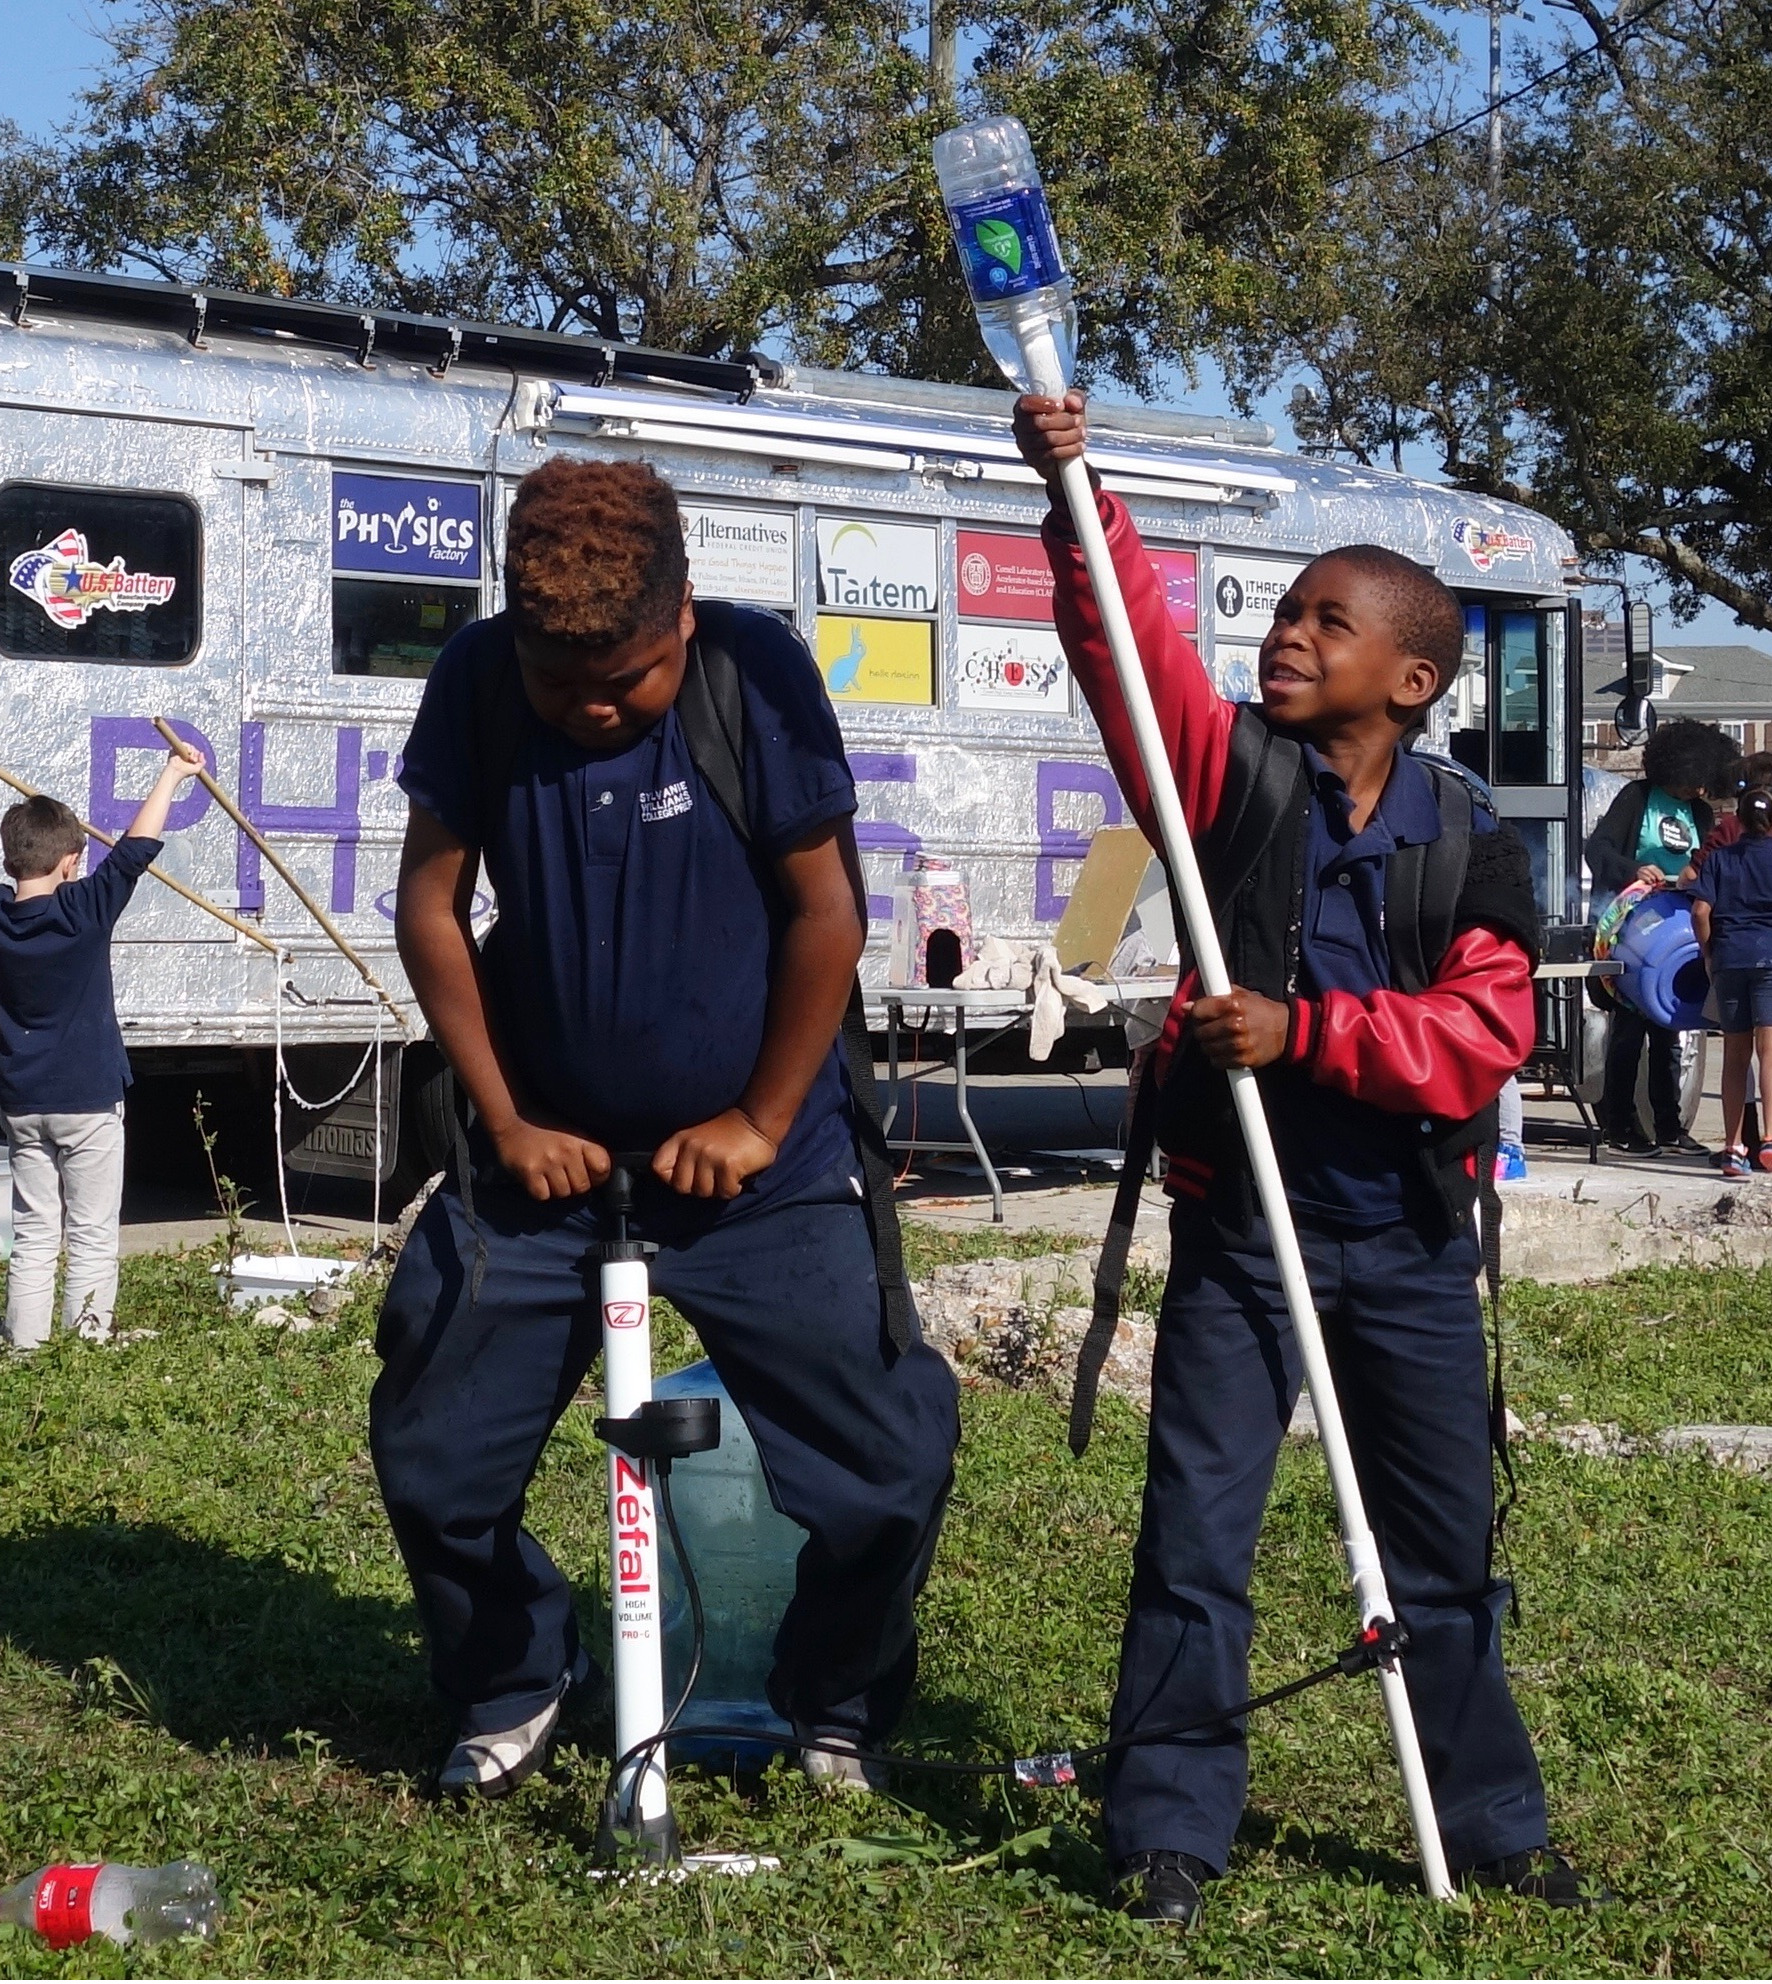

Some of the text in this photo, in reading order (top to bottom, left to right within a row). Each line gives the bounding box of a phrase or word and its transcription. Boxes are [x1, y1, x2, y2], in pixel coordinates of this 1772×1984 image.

[339, 498, 355, 509] the
[338, 502, 474, 553] PHYSICS
[685, 514, 787, 548] Alternatives
[428, 546, 468, 565] Factory
[707, 542, 737, 551] FEDERAL
[995, 564, 1016, 574] Cornell
[827, 567, 928, 609] Taitem
[996, 585, 1007, 593] and
[1007, 586, 1035, 596] Education
[1246, 580, 1287, 596] ITHACA
[639, 781, 688, 803] SYLVANIE
[641, 791, 691, 813] WILLIAMS
[641, 800, 693, 823] COLLEGE PREP
[615, 1456, 651, 1594] Zéfal
[625, 1600, 646, 1609] HIGH
[618, 1612, 653, 1622] VOLUME
